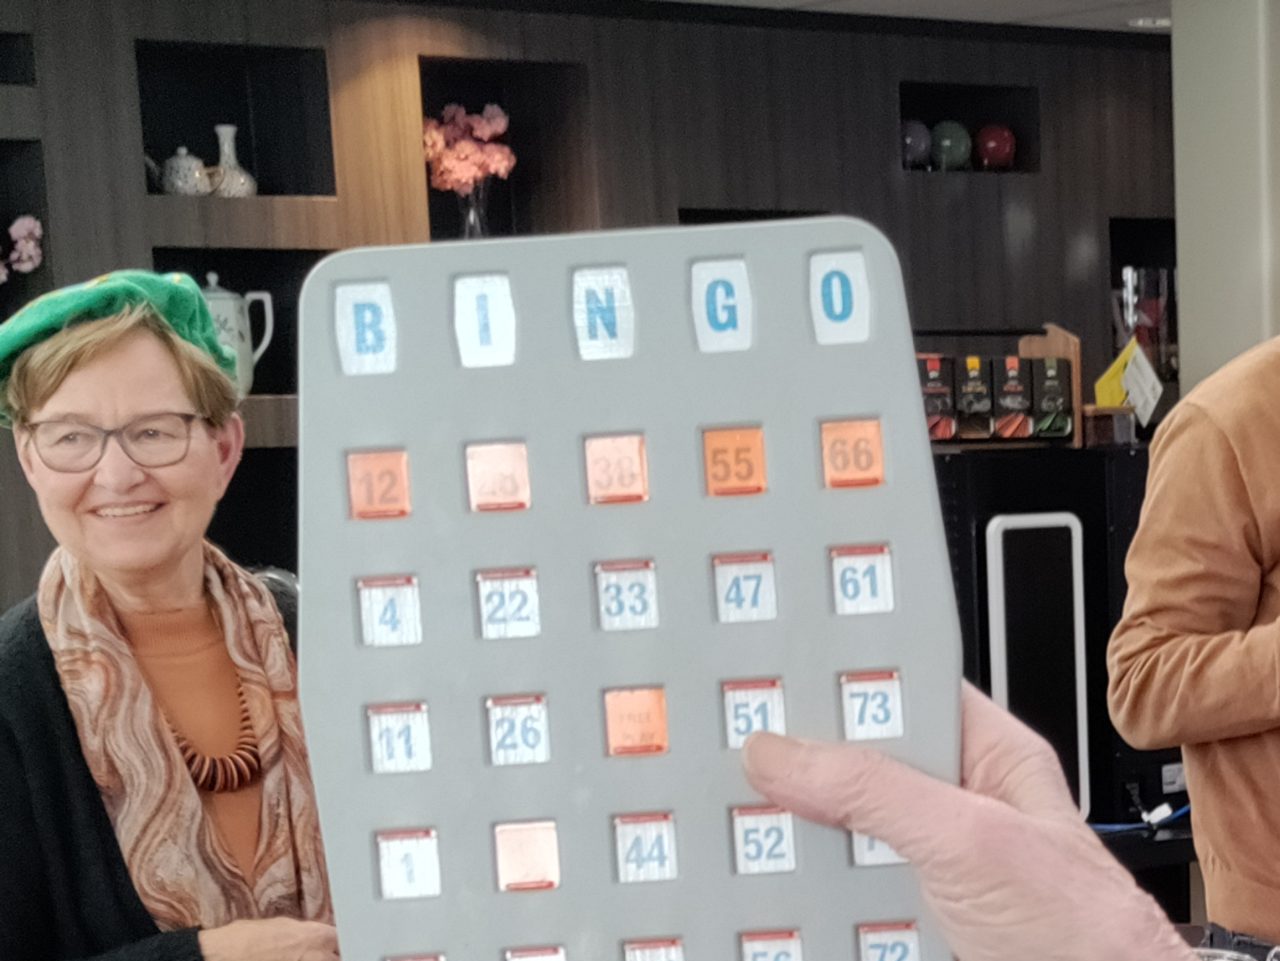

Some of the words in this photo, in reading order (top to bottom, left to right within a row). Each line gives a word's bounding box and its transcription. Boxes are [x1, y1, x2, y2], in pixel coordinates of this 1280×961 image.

[353, 301, 387, 355] B
[585, 287, 620, 341] N
[704, 278, 739, 333] G
[358, 469, 399, 506] 12
[711, 446, 754, 482] 55
[829, 437, 874, 472] 66
[378, 597, 400, 633] 4
[486, 589, 532, 624] 22
[603, 582, 649, 617] 33
[724, 575, 763, 608] 47
[839, 565, 880, 600] 61
[378, 724, 415, 760] 11
[497, 715, 541, 751] 26
[732, 701, 772, 735] 51
[849, 690, 891, 725] 73
[401, 852, 415, 883] 1
[624, 833, 669, 867] 44
[743, 826, 785, 861] 52
